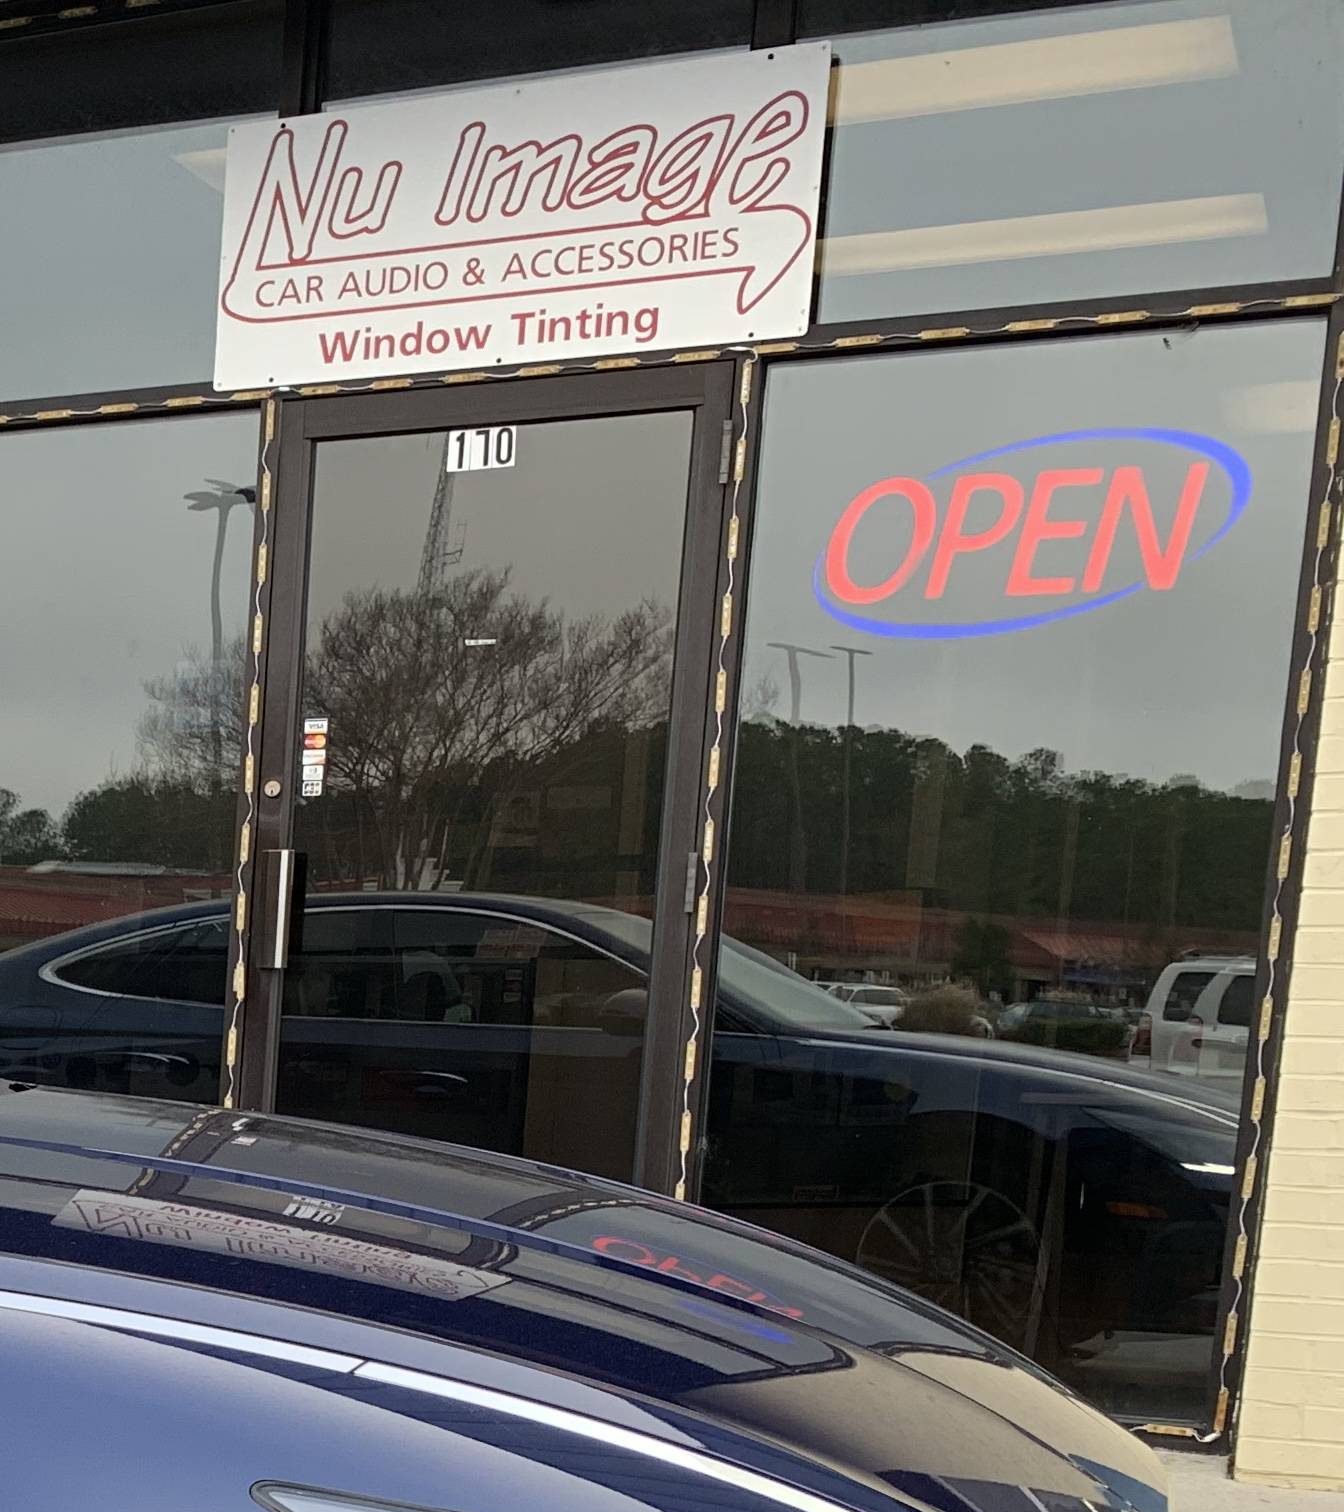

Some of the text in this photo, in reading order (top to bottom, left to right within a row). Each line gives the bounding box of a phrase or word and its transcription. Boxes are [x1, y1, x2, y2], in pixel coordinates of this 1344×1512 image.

[234, 89, 810, 264] Nu Image
[255, 227, 740, 309] CAR AUDIO & ACCESSORIES
[318, 302, 660, 365] Window Tinting
[825, 458, 1210, 605] OPEN
